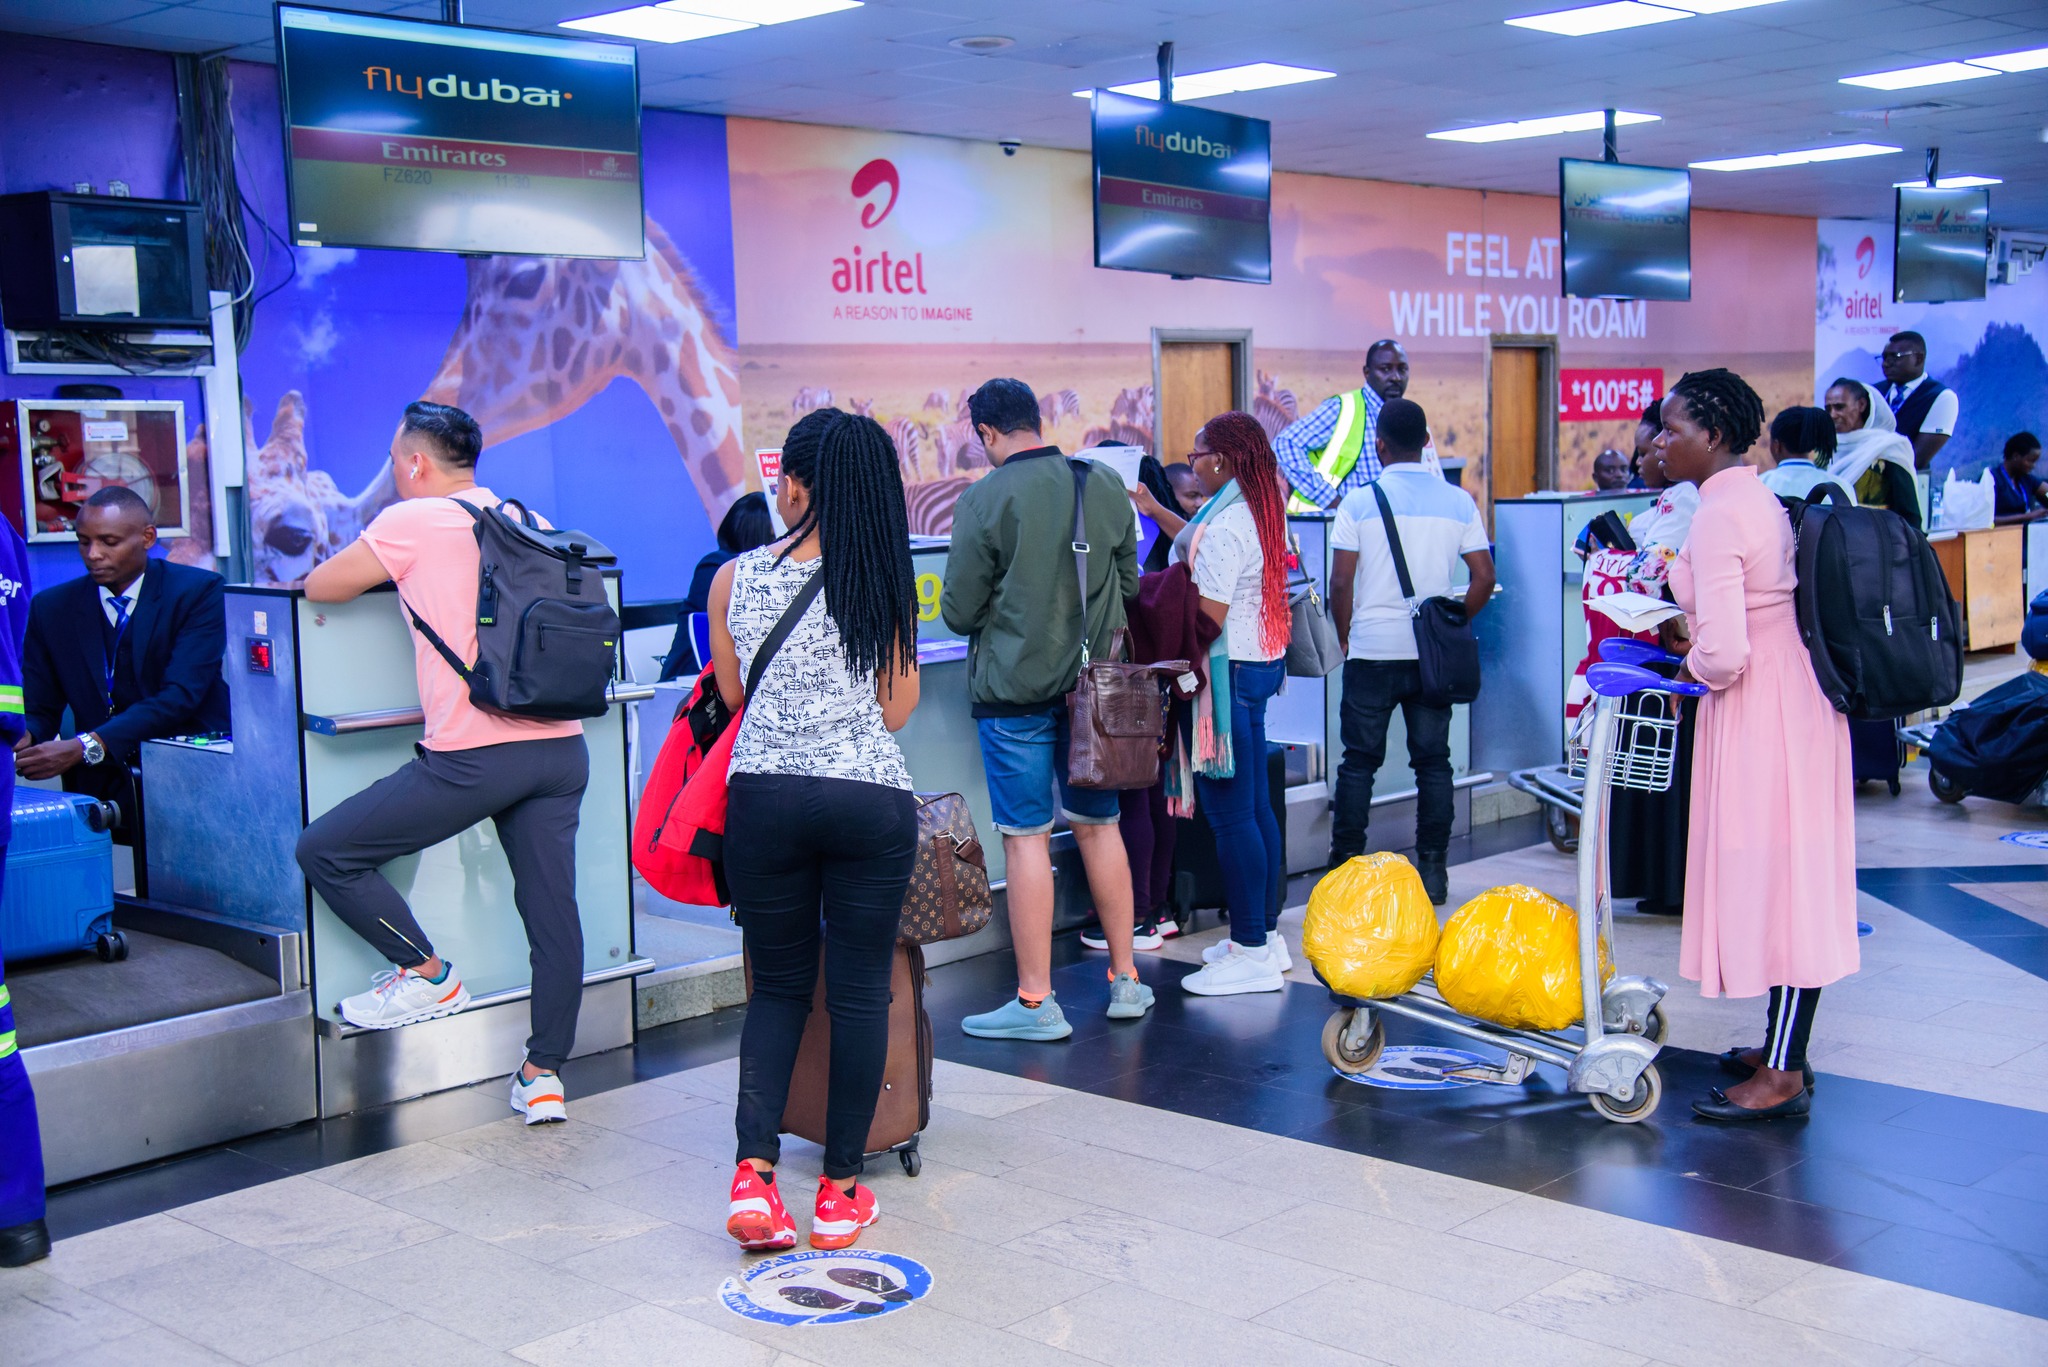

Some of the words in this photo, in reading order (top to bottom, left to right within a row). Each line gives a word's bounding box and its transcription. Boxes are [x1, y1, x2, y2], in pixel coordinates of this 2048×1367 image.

[362, 65, 562, 108] flydubai
[381, 141, 508, 168] Emirates
[1135, 125, 1232, 160] flydubai
[383, 166, 432, 186] FZ620
[1142, 188, 1205, 211] Emirates
[831, 245, 928, 295] airtel
[1446, 231, 1518, 279] FEEL
[1525, 236, 1559, 280] AT
[833, 305, 843, 320] A
[846, 305, 898, 321] REASON
[901, 306, 919, 321] TO
[921, 307, 973, 321] IMAGINE
[1389, 290, 1491, 337] WHILE
[1498, 294, 1560, 335] YOU
[1567, 299, 1647, 339] ROAM
[1845, 289, 1883, 319] airtel
[761, 455, 777, 465] Not
[915, 572, 943, 622] 9
[794, 1248, 881, 1261] DISTANCE
